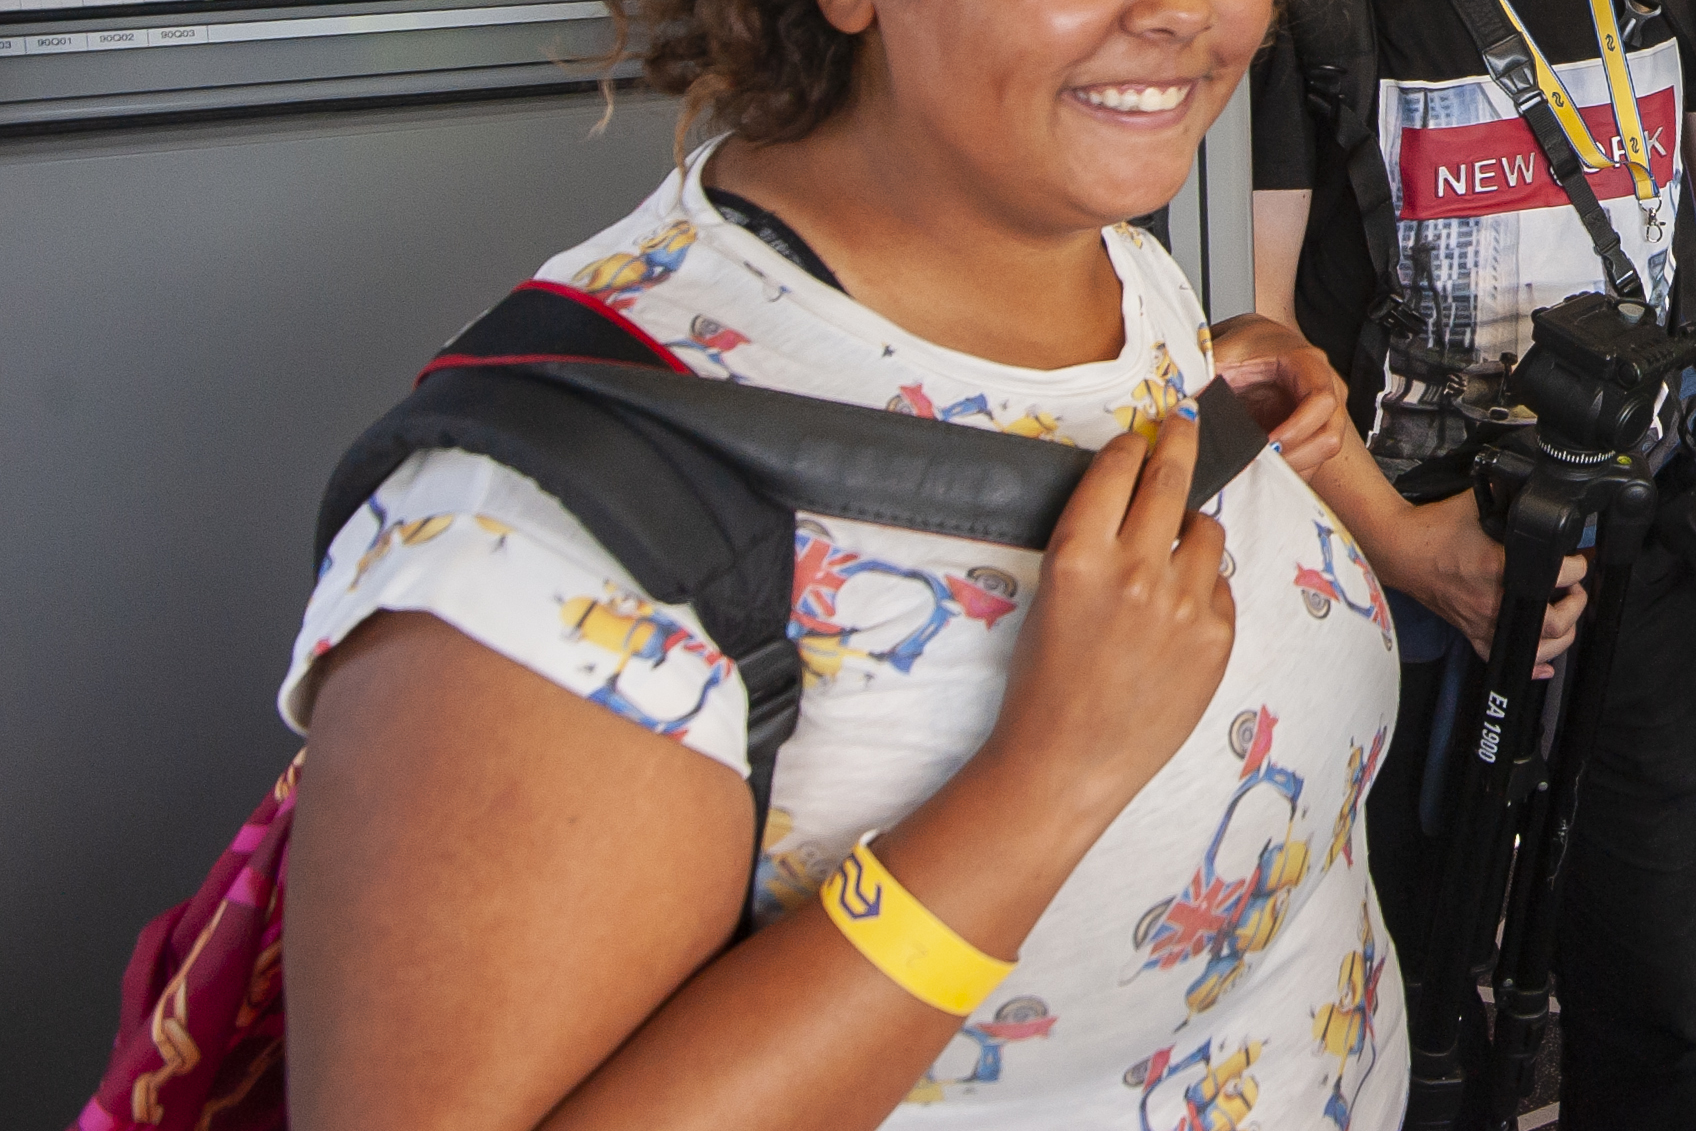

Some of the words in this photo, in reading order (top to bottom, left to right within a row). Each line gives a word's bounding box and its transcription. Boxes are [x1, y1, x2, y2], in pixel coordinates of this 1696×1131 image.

[1435, 151, 1536, 199] NEW
[1549, 126, 1668, 188] RK
[1486, 690, 1508, 719] EA
[1478, 721, 1502, 764] 1900
